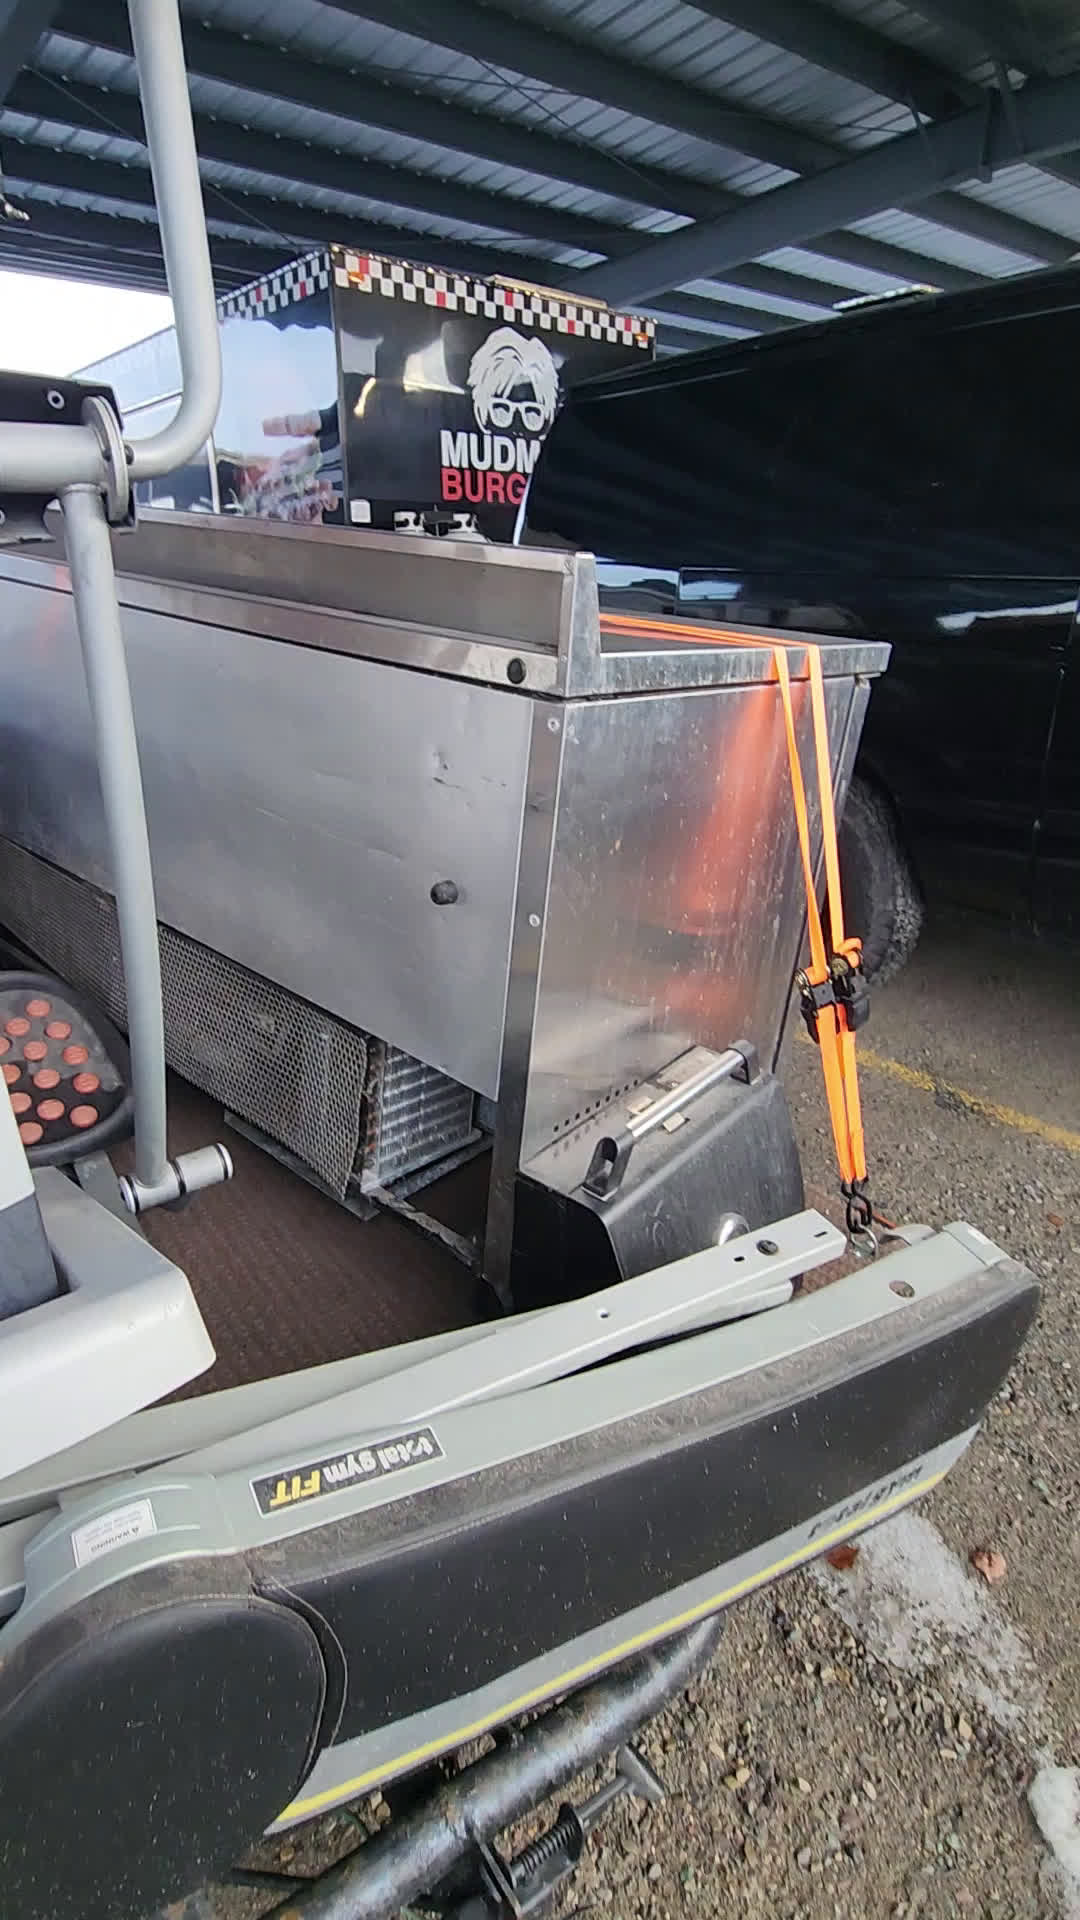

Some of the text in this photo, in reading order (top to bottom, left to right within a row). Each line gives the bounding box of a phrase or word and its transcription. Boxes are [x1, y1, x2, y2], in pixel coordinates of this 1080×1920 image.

[440, 467, 527, 505] BURG
[269, 1436, 434, 1508] total gym FIT
